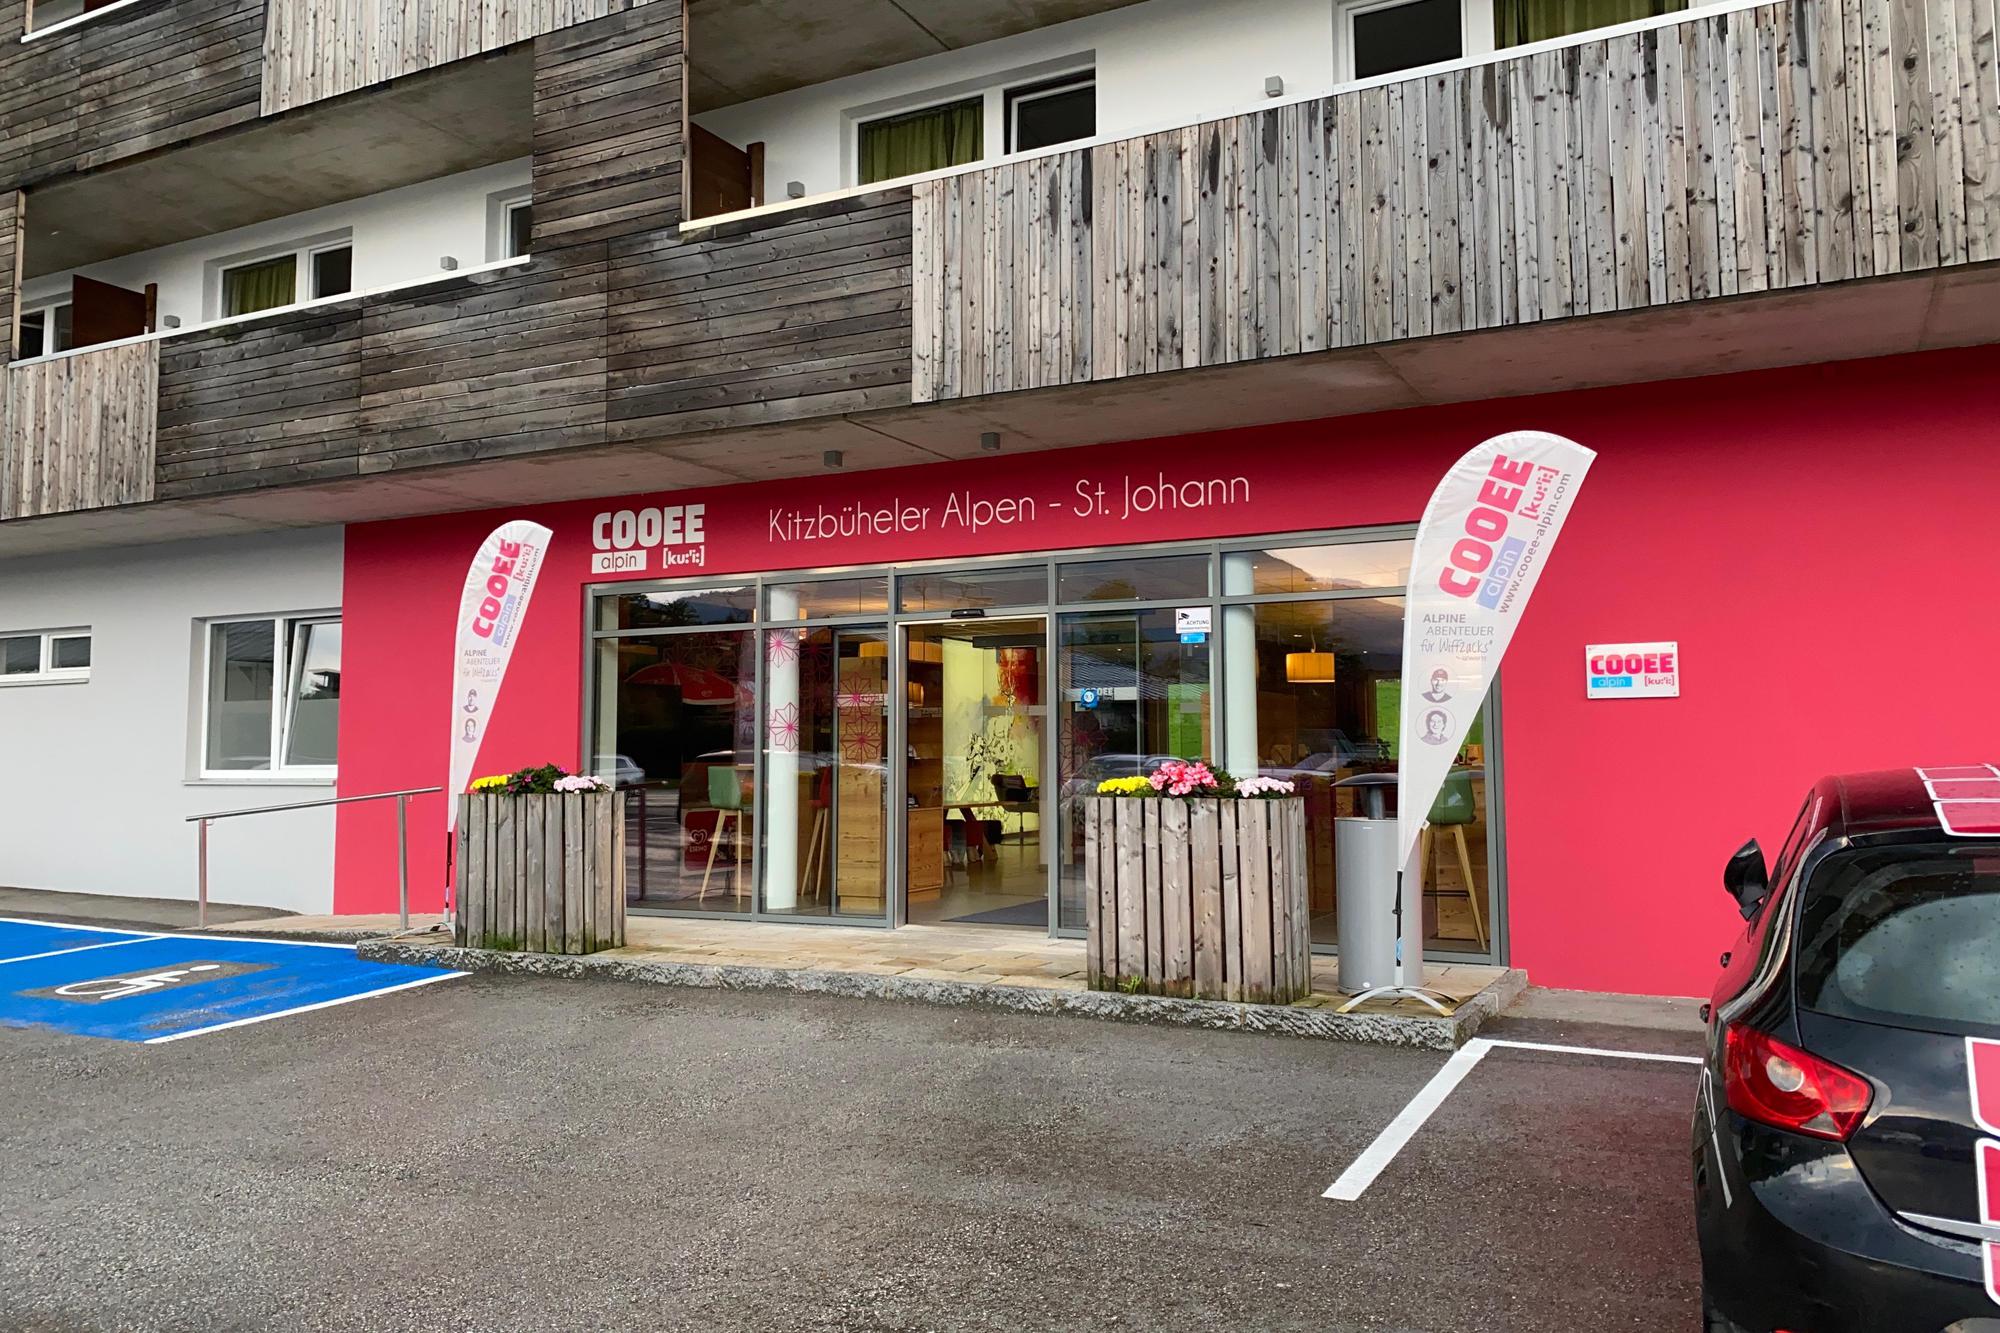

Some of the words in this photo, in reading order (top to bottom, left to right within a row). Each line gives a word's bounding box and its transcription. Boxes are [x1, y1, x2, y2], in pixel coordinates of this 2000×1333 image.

[592, 504, 705, 550] COOEE
[769, 497, 930, 543] Kitzbüheler
[941, 490, 1036, 534] Alpen
[1073, 479, 1110, 517] St.
[1120, 471, 1250, 520] Johann
[1438, 453, 1535, 599] COOEE
[601, 553, 637, 572] alpin
[1499, 473, 1572, 614] www.cooee-alpin.com
[473, 539, 520, 638] COOEE
[1486, 549, 1520, 597] alpin
[1423, 613, 1467, 624] ALPINE
[1426, 625, 1495, 636] ABENTEUER
[464, 649, 488, 657] ALPINE
[1591, 653, 1674, 675] COOEE
